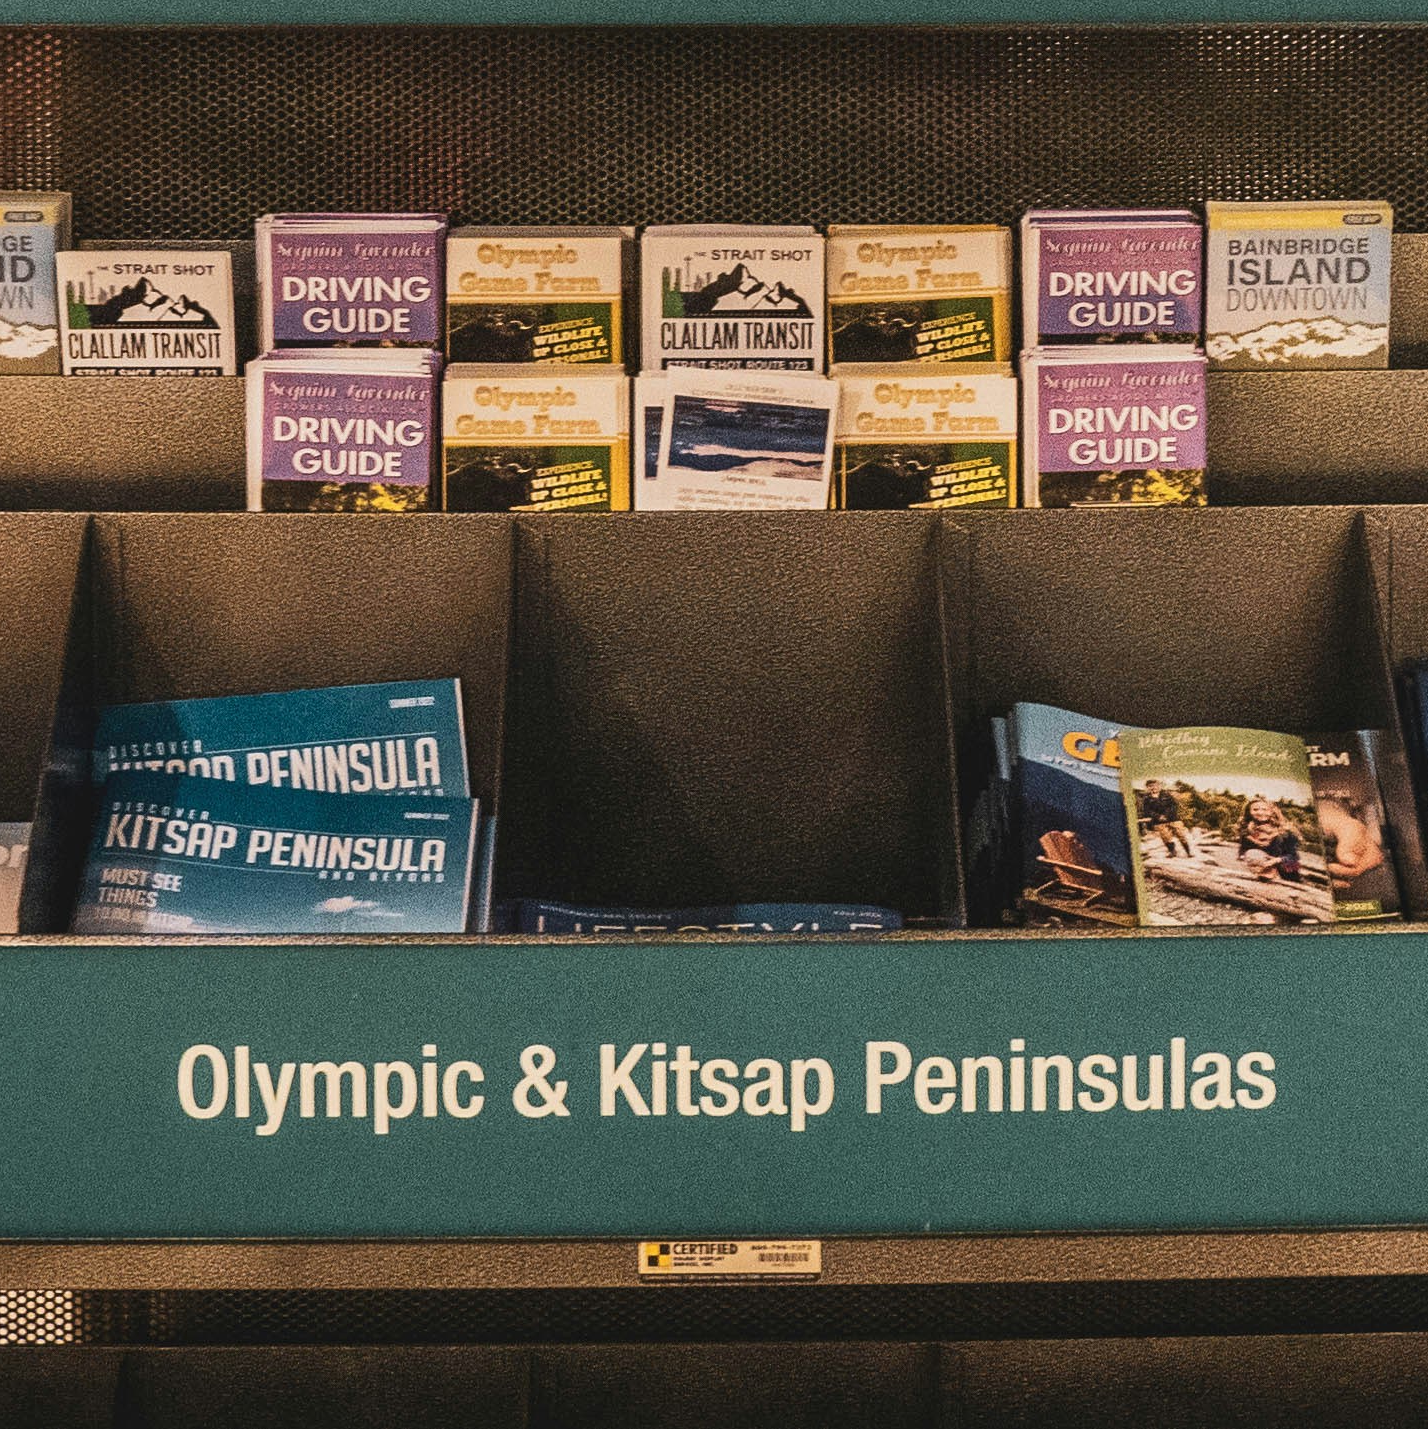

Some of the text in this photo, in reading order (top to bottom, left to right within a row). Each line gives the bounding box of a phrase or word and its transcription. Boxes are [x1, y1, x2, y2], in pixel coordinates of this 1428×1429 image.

[711, 249, 812, 262] STRAIT SHOT
[281, 276, 432, 303] DRIVING
[1049, 270, 1197, 297] DRIVING
[303, 307, 411, 335] GUIDE
[1068, 301, 1175, 328] GUIDE
[661, 322, 813, 350] CLALLAM TRANSIT
[273, 415, 425, 447] DRIVING
[1048, 404, 1199, 434] DRIVING
[292, 447, 403, 477] GUIDE
[1068, 436, 1178, 465] GUIDE
[103, 813, 447, 872] KITSAP PENINSULA
[100, 868, 182, 892] MUST SEE
[98, 886, 159, 908] THINGS
[177, 1037, 1278, 1136] Olympic & Kitsap Peninsulas
[673, 1243, 739, 1255] CERTIFIED
